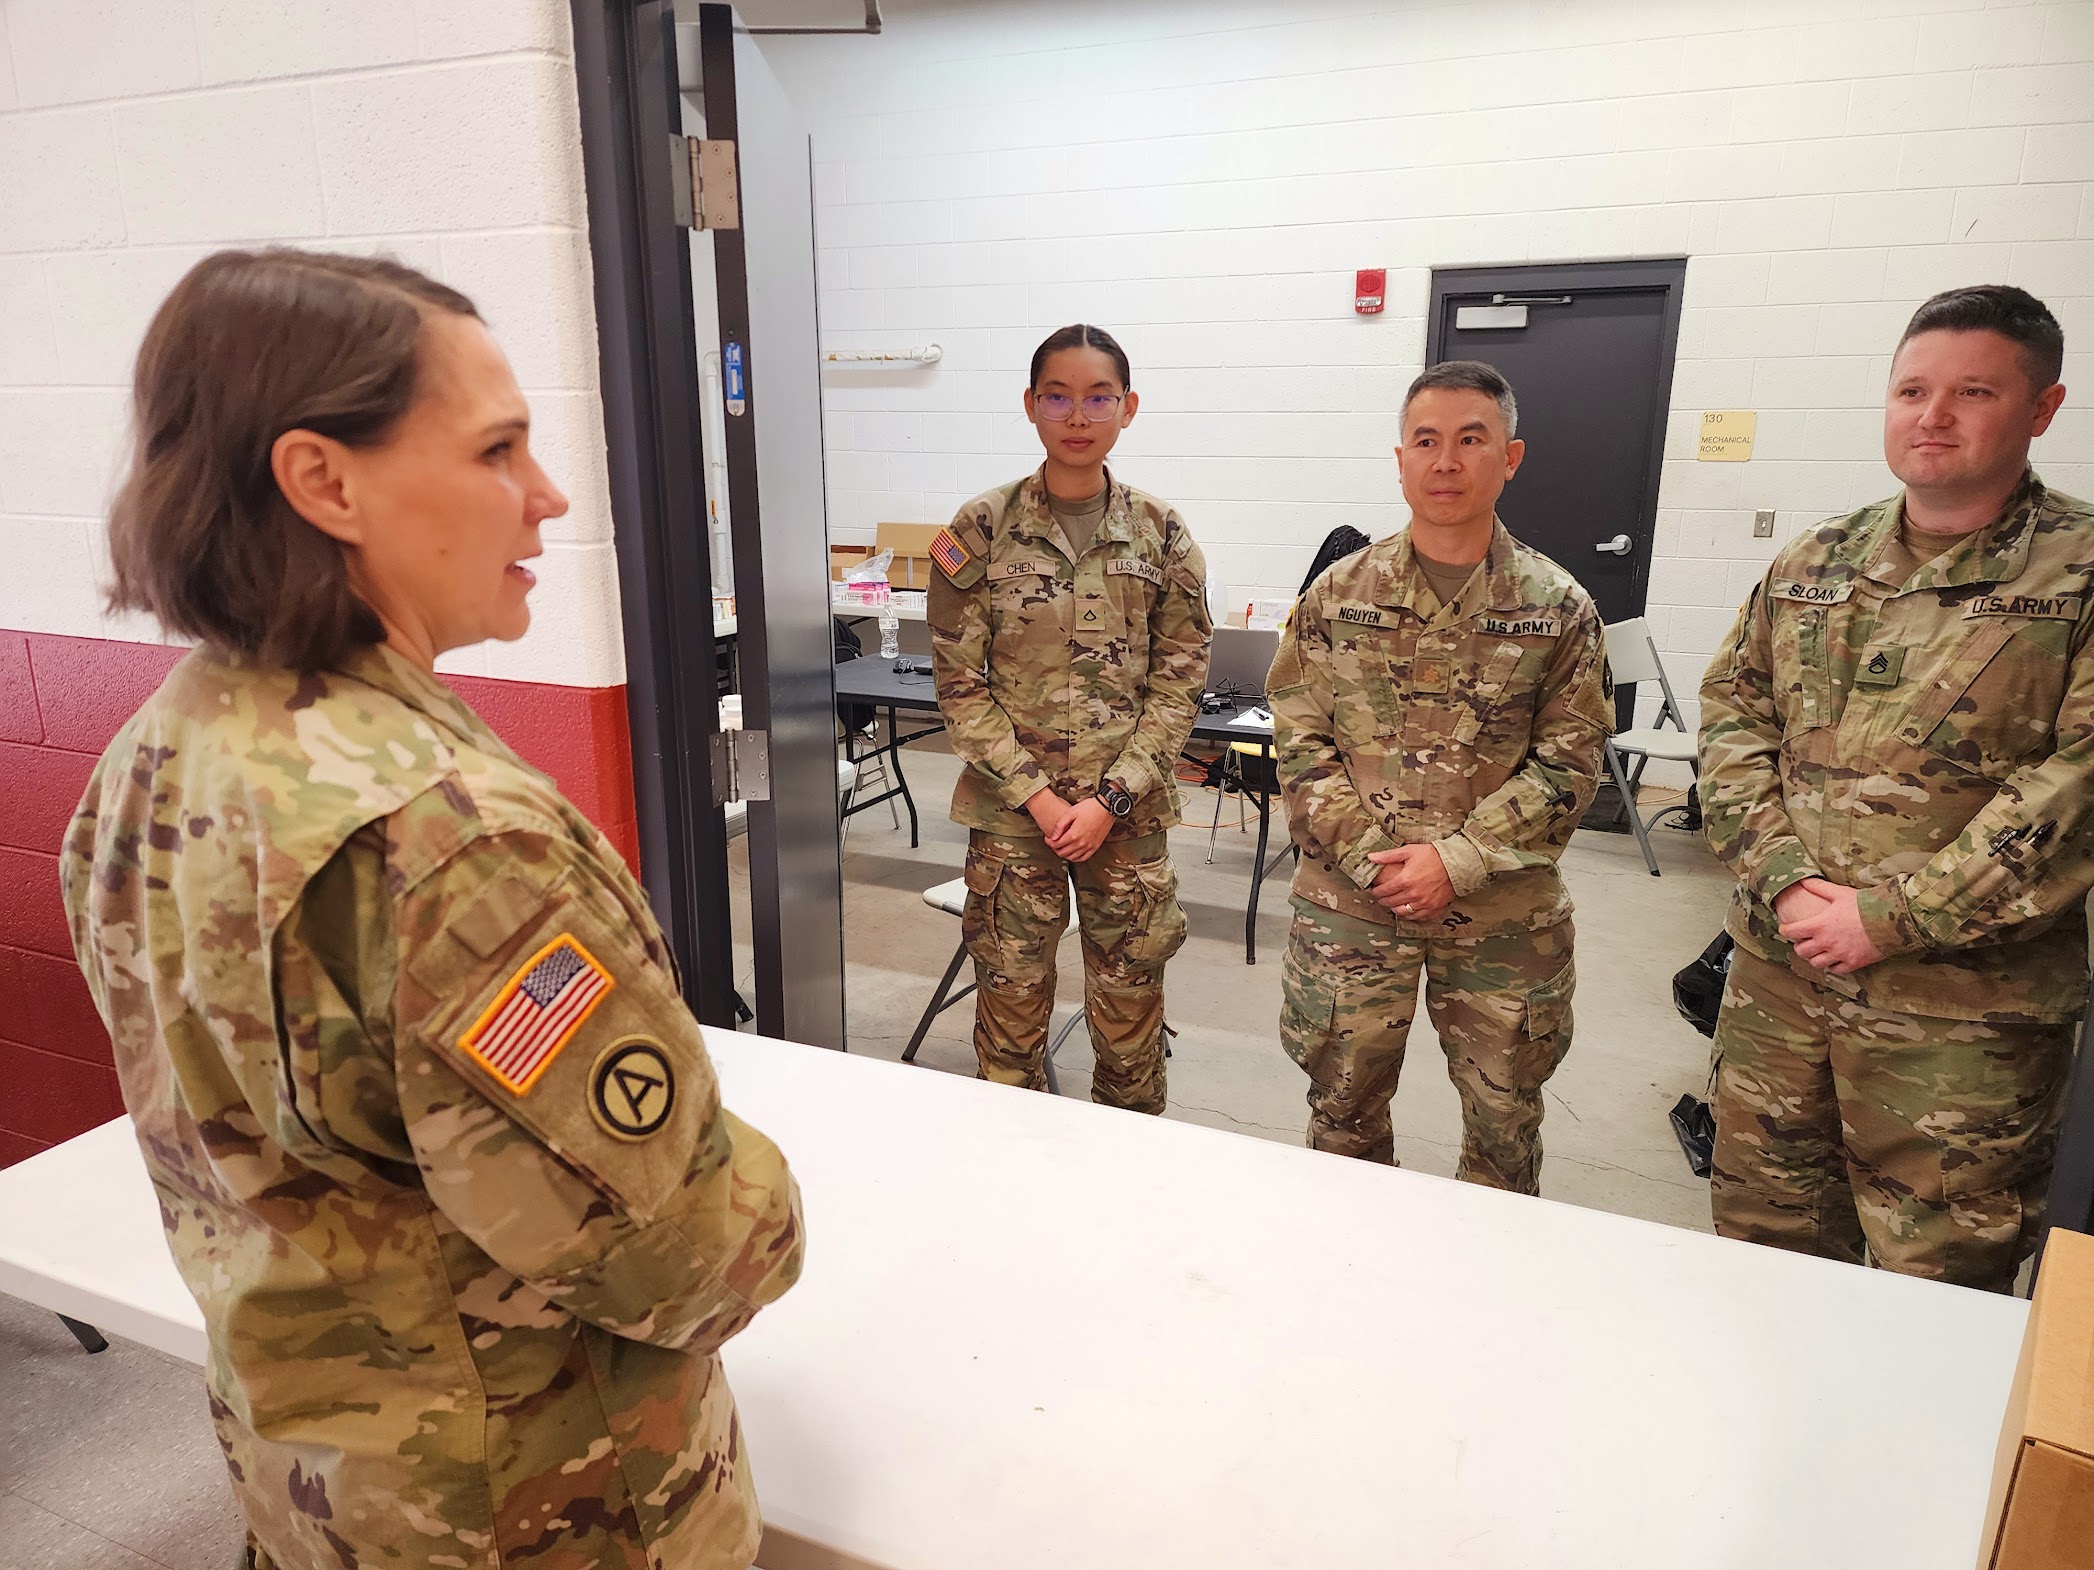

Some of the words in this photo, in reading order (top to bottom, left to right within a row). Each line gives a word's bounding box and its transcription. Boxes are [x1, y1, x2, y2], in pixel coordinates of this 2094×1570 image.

[1704, 413, 1723, 423] 130
[1700, 436, 1751, 444] MECHANICAL
[1699, 445, 1725, 453] ROOM
[1005, 561, 1036, 575] CHEN
[1115, 560, 1135, 572] U.S.
[1137, 564, 1160, 581] ARMY
[1788, 583, 1839, 602] SLOAN
[2007, 595, 2068, 615] ARMY
[1338, 606, 1382, 624] NGUYEN
[1511, 620, 1554, 634] ARMY
